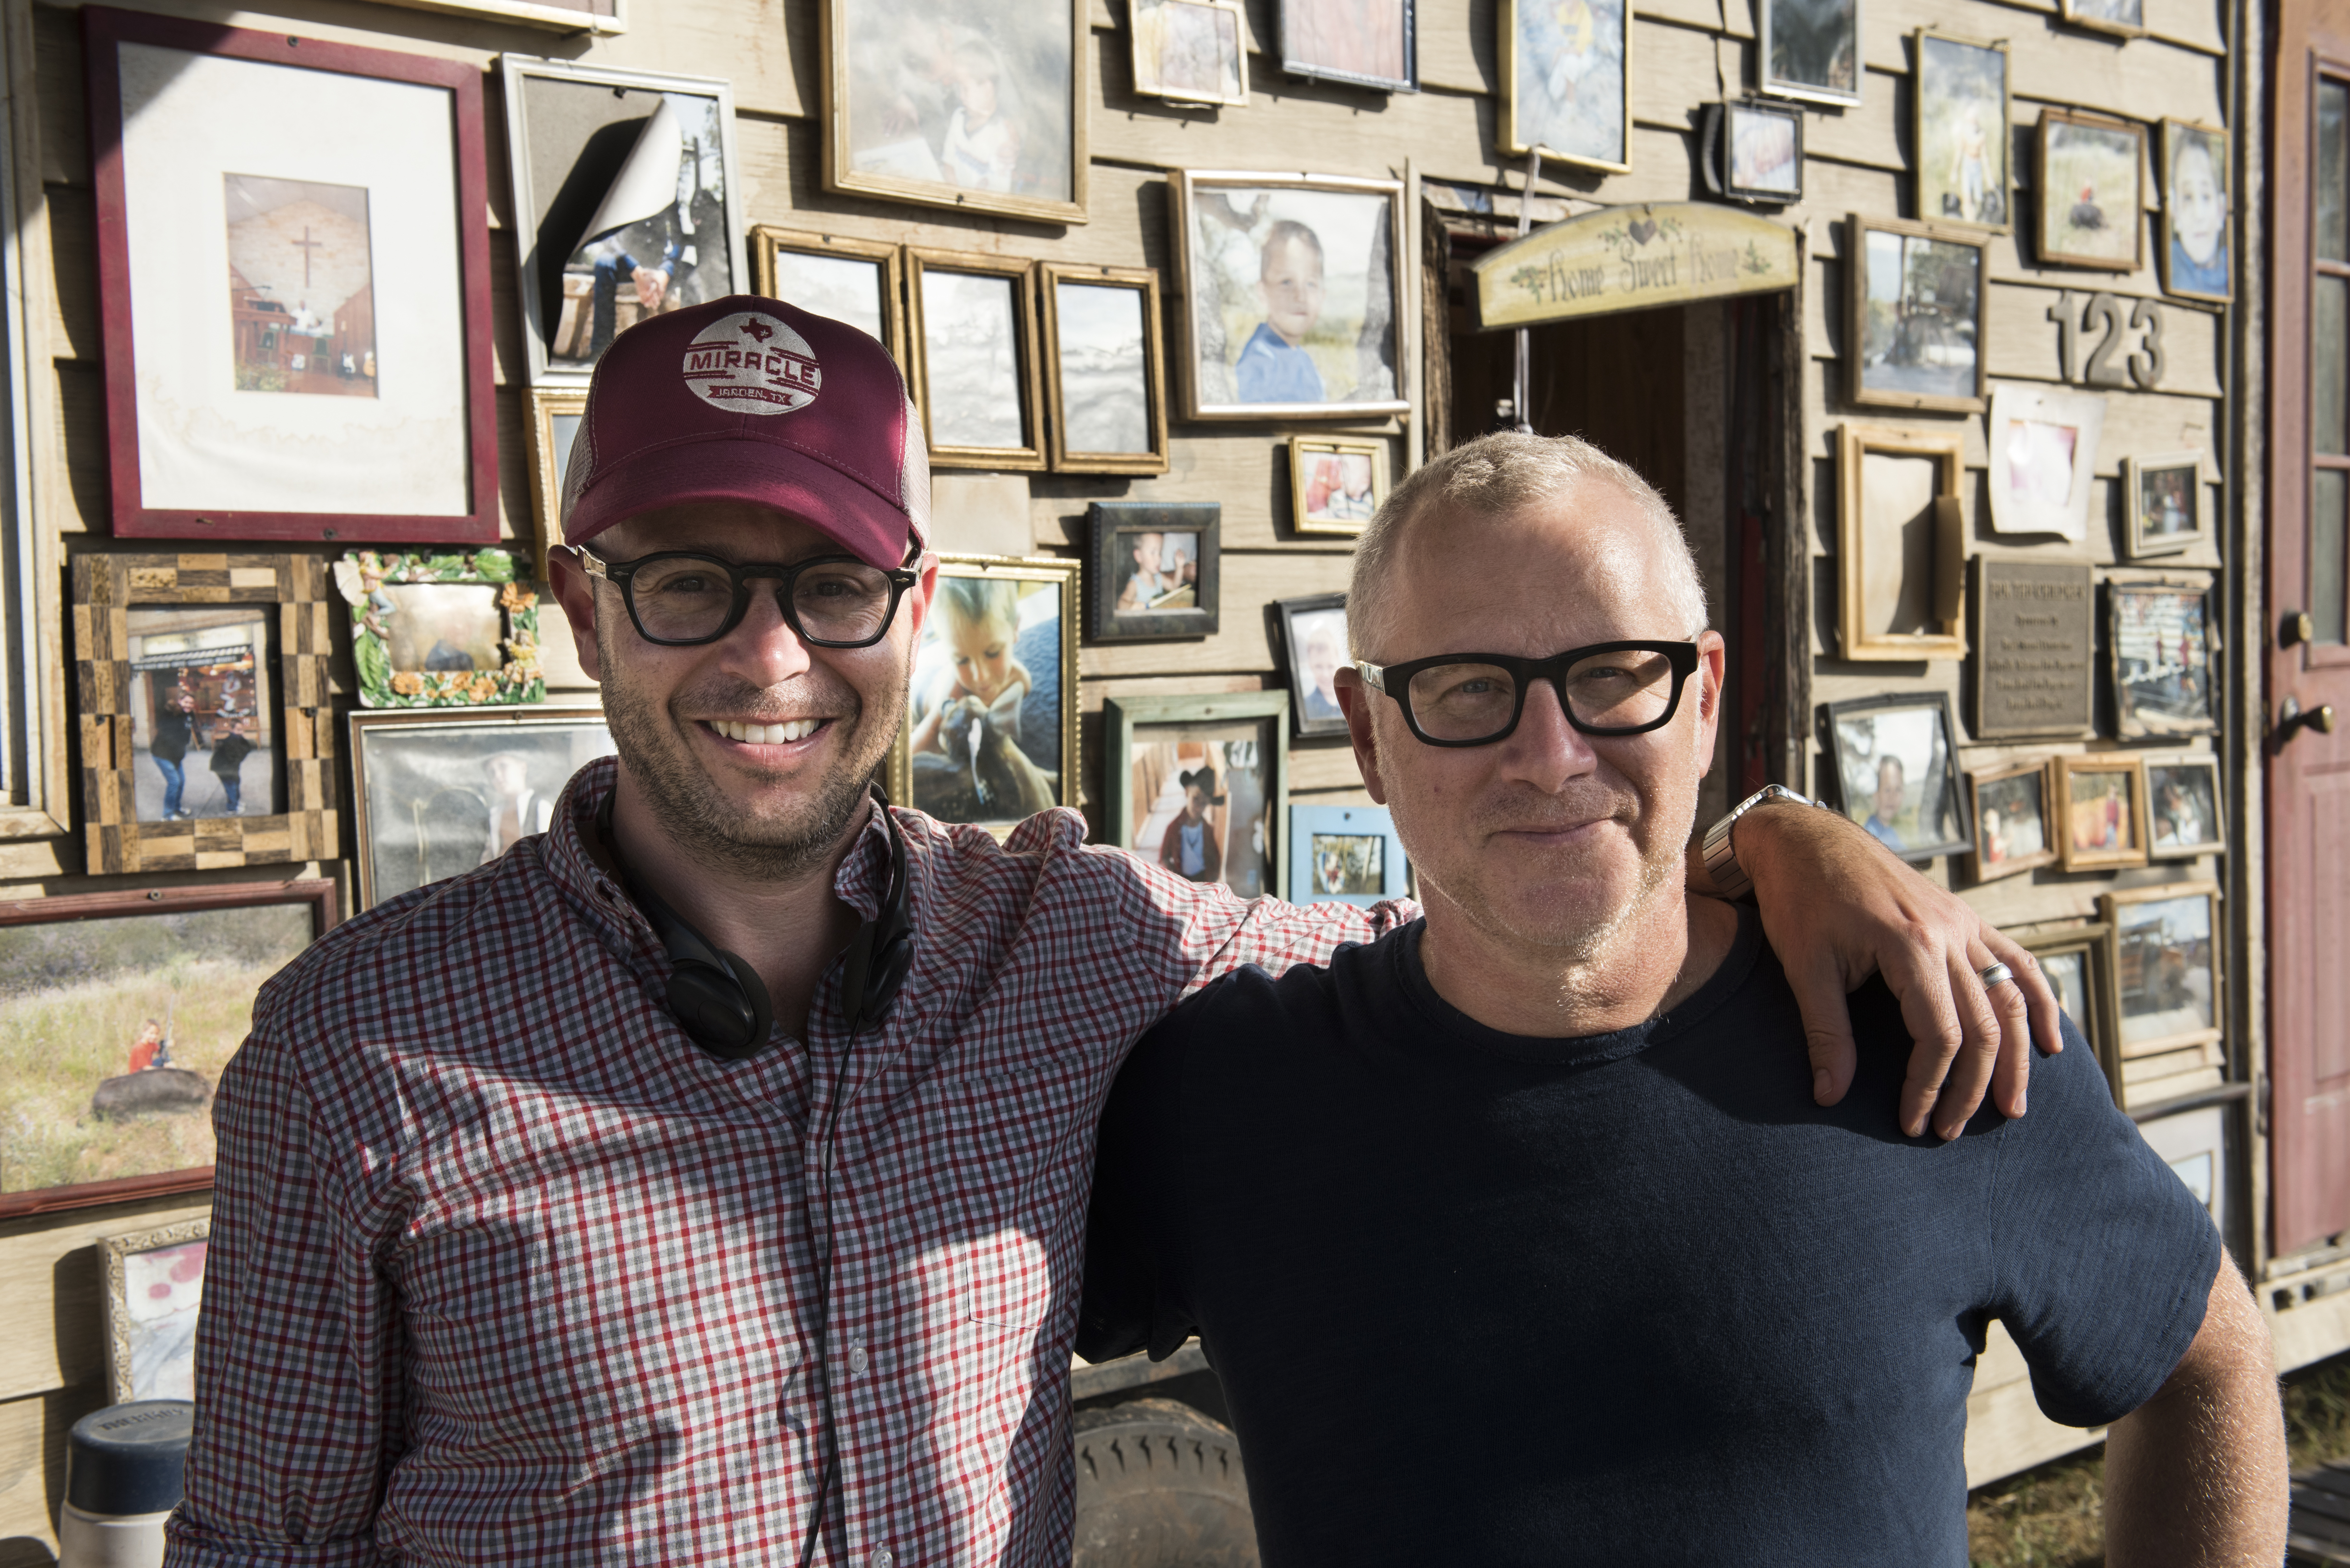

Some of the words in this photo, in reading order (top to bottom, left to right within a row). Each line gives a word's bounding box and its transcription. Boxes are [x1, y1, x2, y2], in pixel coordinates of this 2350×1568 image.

[1548, 249, 1606, 303] Home
[1619, 240, 1677, 294] Sweet
[1689, 232, 1739, 285] Home
[2051, 289, 2165, 389] 123
[690, 350, 816, 386] MIRACLE
[770, 393, 785, 403] TX
